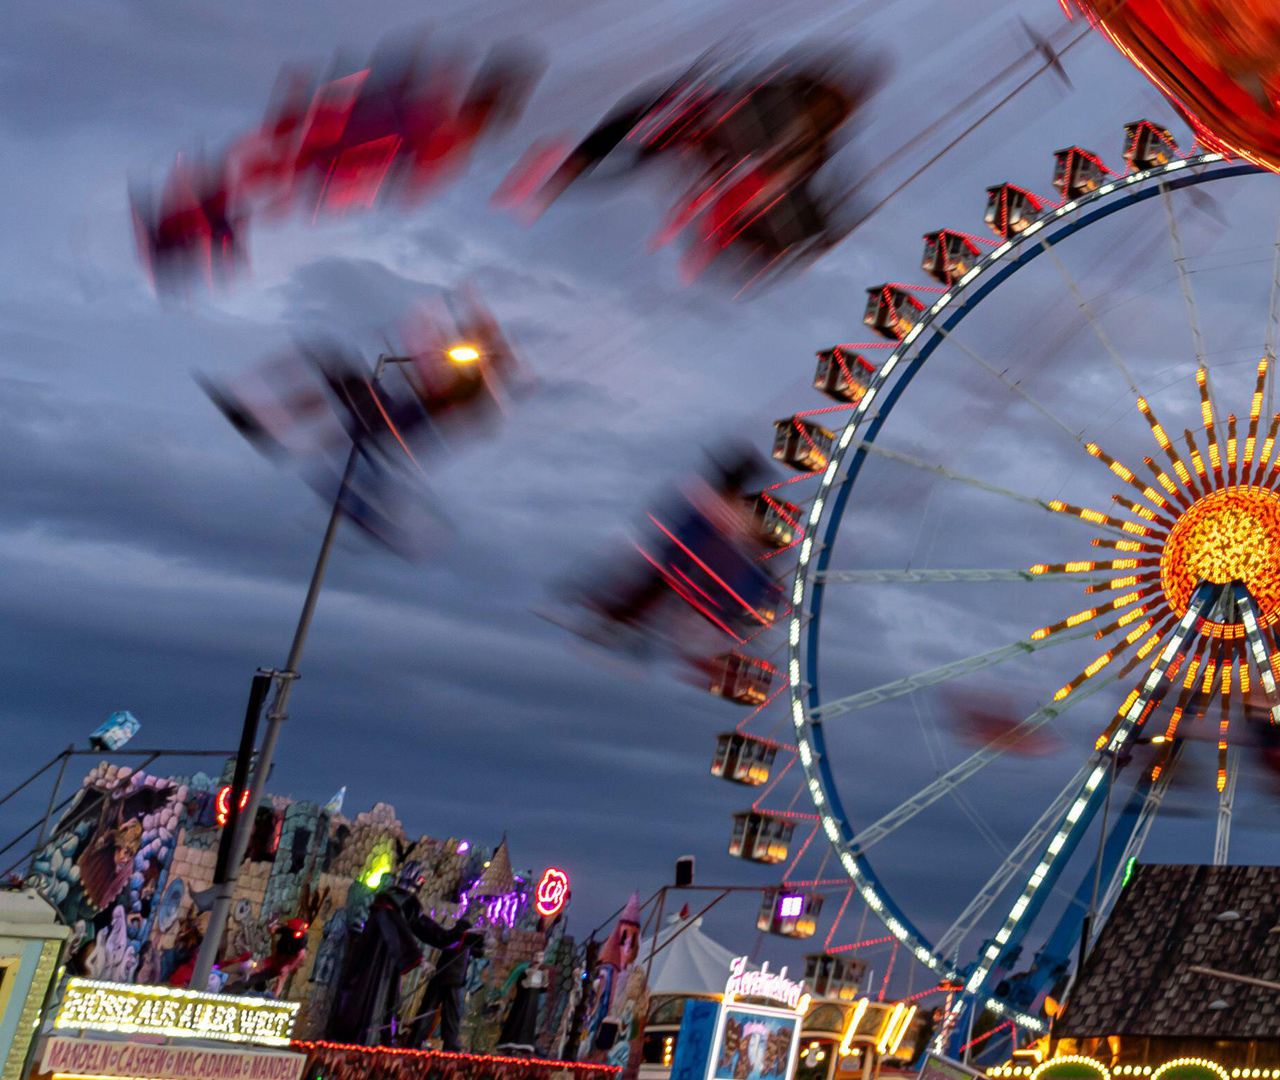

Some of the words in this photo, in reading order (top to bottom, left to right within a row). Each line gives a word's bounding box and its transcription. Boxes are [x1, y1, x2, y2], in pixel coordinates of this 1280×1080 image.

[48, 1040, 113, 1071] MANDELN
[117, 1045, 170, 1075] CASHEW
[172, 1050, 244, 1080] MACADAMIA
[249, 1055, 302, 1080] MANDELN
